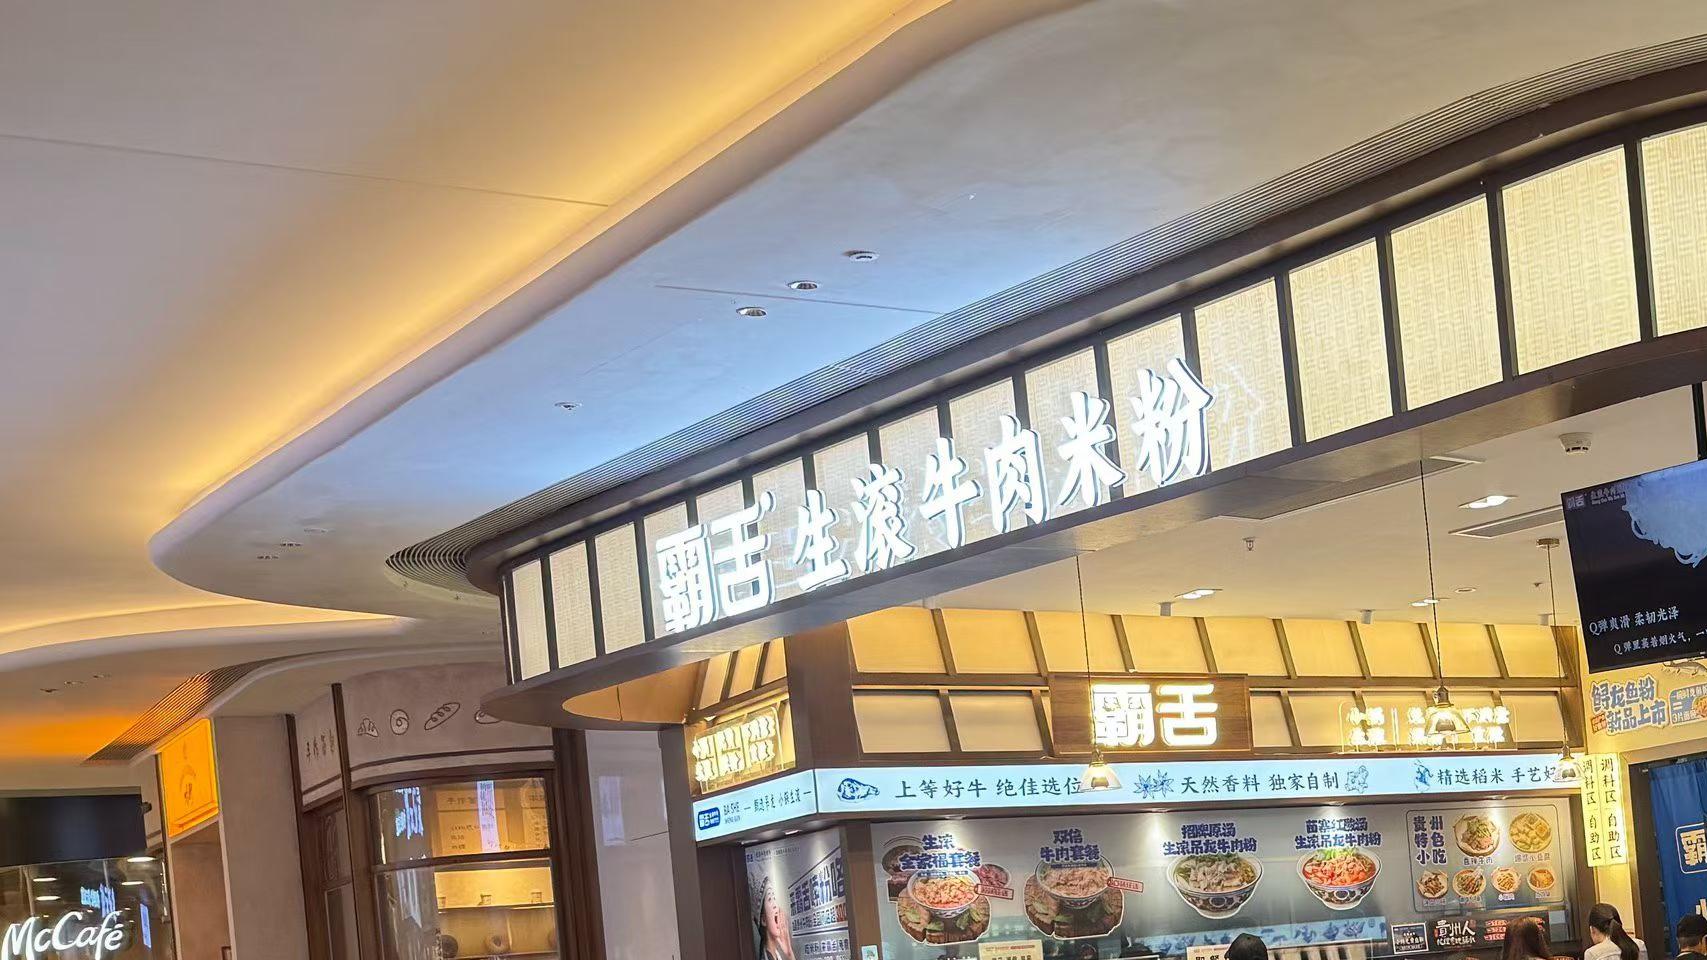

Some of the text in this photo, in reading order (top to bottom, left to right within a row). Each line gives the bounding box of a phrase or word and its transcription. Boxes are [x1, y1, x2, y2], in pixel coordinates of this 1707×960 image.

[656, 357, 1213, 631] 霸舌 生滚牛肉米粉
[1589, 615, 1631, 636] Q弹爽滑
[1591, 676, 1655, 712] 鲟龙鱼粉
[1093, 683, 1218, 747] 霸舌
[1607, 701, 1666, 732] 新品上市
[895, 780, 987, 799] 上等好牛
[996, 776, 1084, 797] 绝佳选位
[1181, 775, 1260, 794] 天然香料
[1268, 772, 1339, 790] 独家自制
[1437, 770, 1504, 786] 精选稻米
[1181, 823, 1236, 839] 招牌原汤
[1414, 816, 1443, 832] 贵州
[922, 834, 954, 850] 生滚
[1053, 828, 1082, 845] 双倍
[1295, 833, 1381, 850] 生滚吊龙牛肉粉
[1415, 832, 1445, 848] 特色
[1608, 813, 1622, 858] 自助区
[1040, 844, 1100, 862] 牛肉套餐
[1163, 839, 1257, 856] 生滚吊龙牛肉粉
[900, 851, 982, 870] 全家福套餐
[1416, 849, 1447, 865] 小吃
